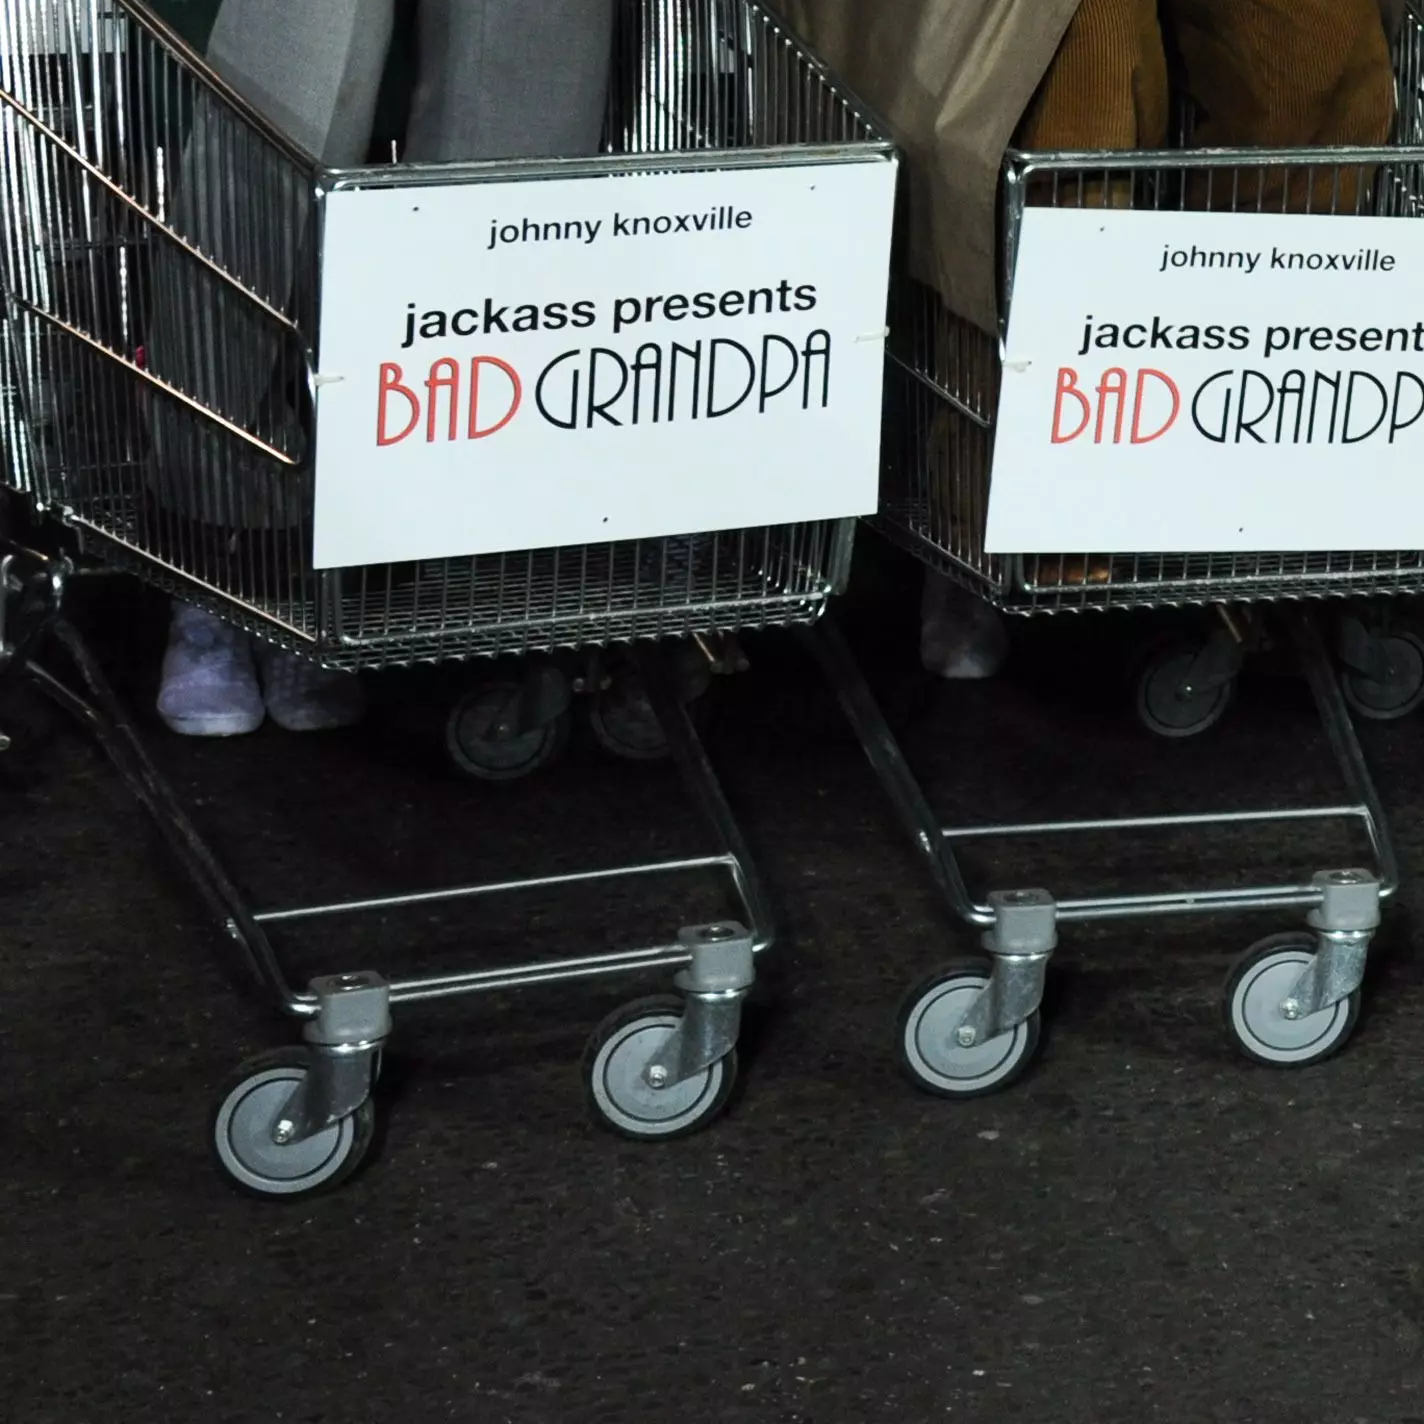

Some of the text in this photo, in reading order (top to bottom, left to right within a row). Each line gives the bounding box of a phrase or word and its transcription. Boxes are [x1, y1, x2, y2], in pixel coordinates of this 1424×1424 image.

[487, 206, 752, 250] johnny knoxville
[1159, 244, 1395, 274] johnny knoxville
[401, 280, 817, 348] jackass presents
[1078, 315, 1250, 356] jackass
[376, 328, 831, 446] BAD GRANDPA
[1051, 367, 1180, 444] BAD
